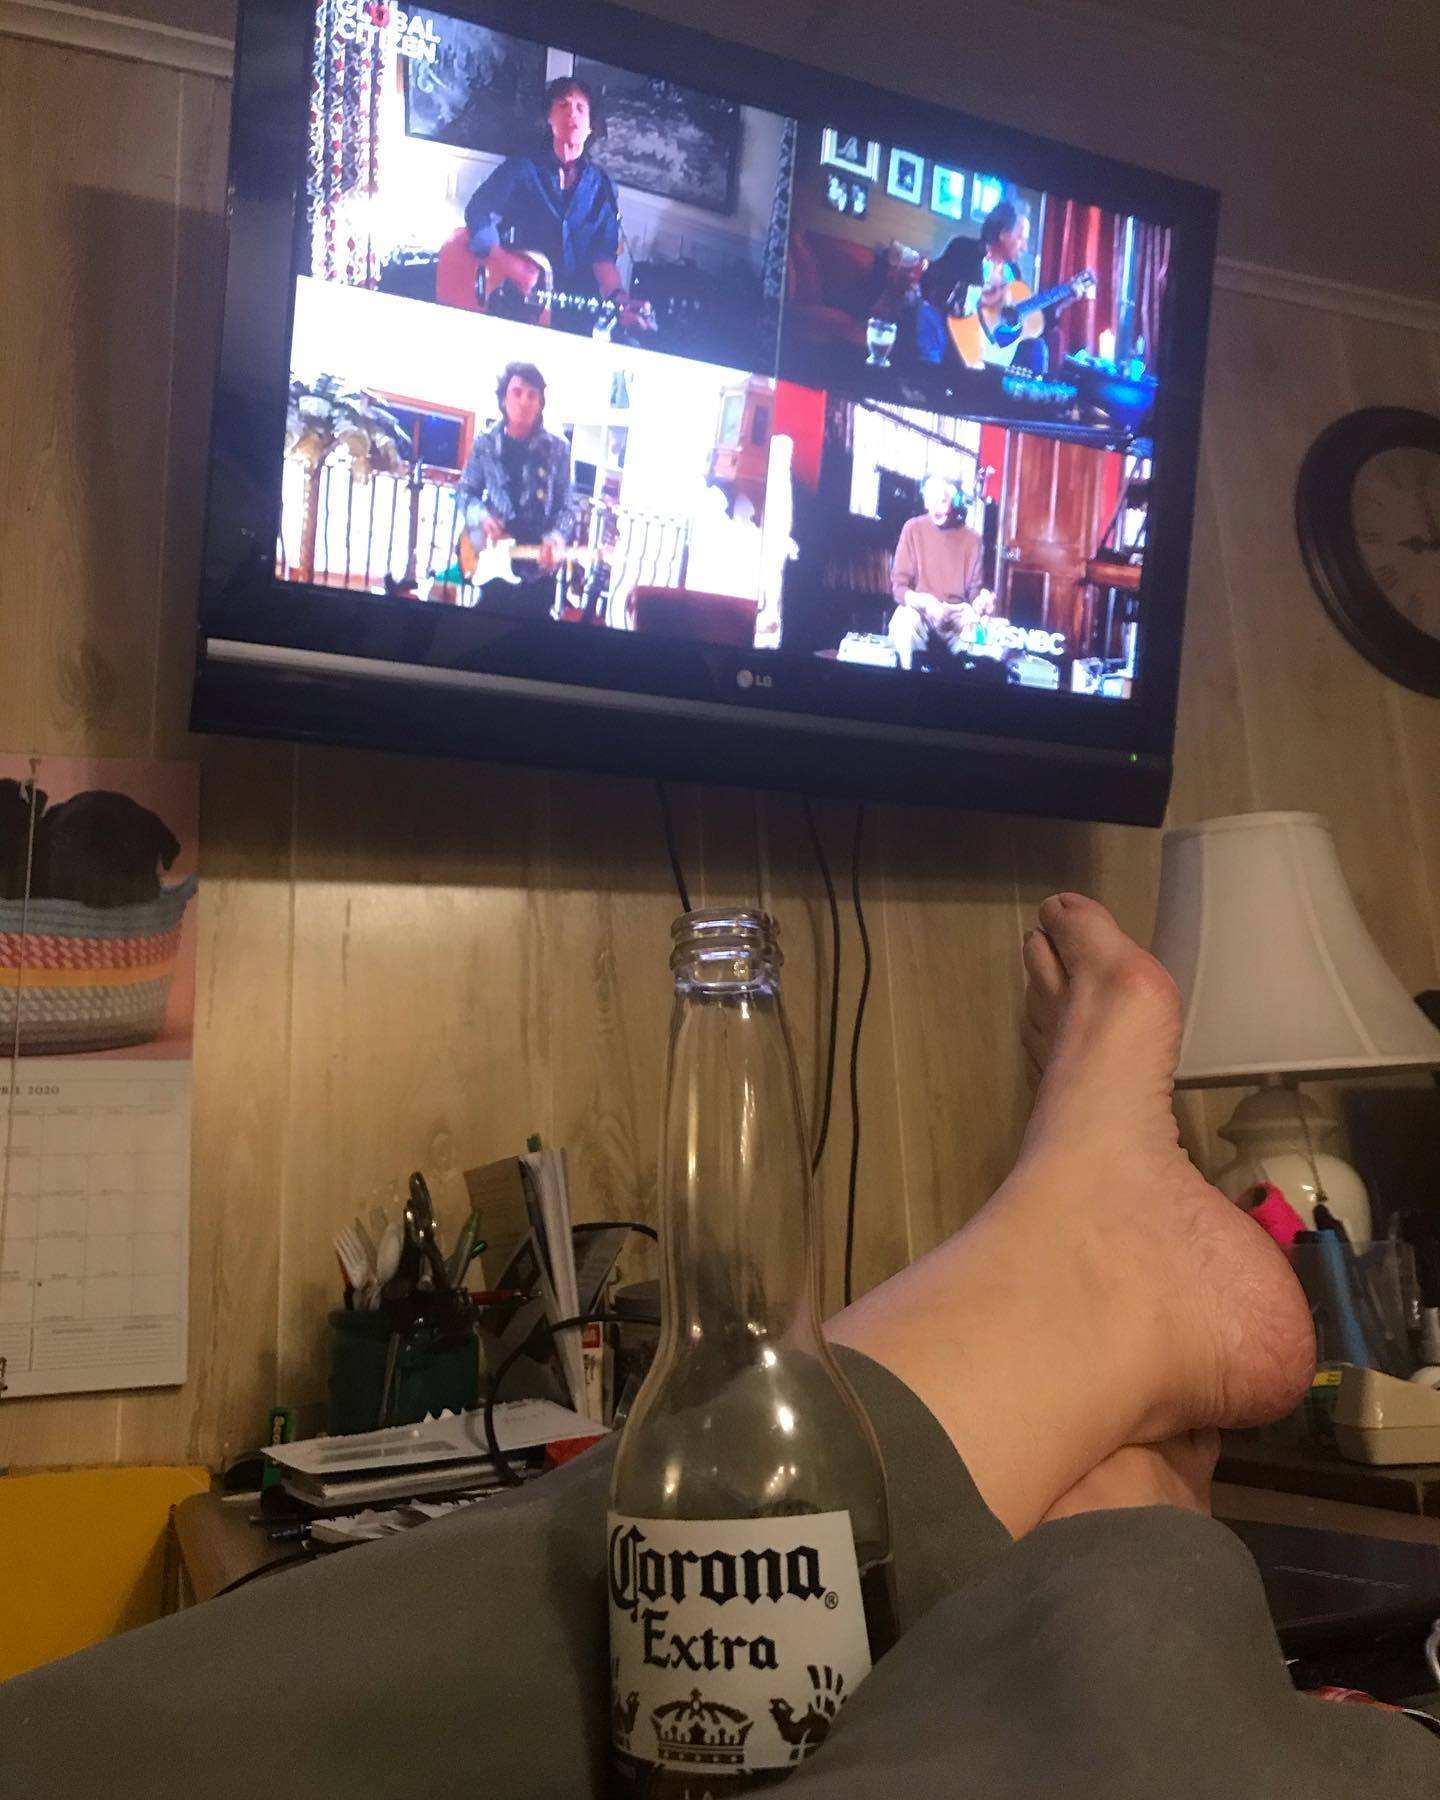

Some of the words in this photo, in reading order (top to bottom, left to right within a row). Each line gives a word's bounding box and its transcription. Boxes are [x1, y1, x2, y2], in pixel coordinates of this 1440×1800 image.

[334, 17, 438, 64] CITIZEN
[336, 0, 440, 44] GLOBAL
[27, 1085, 60, 1096] 2020
[609, 1524, 826, 1623] Corona
[641, 1608, 779, 1671] Extra
